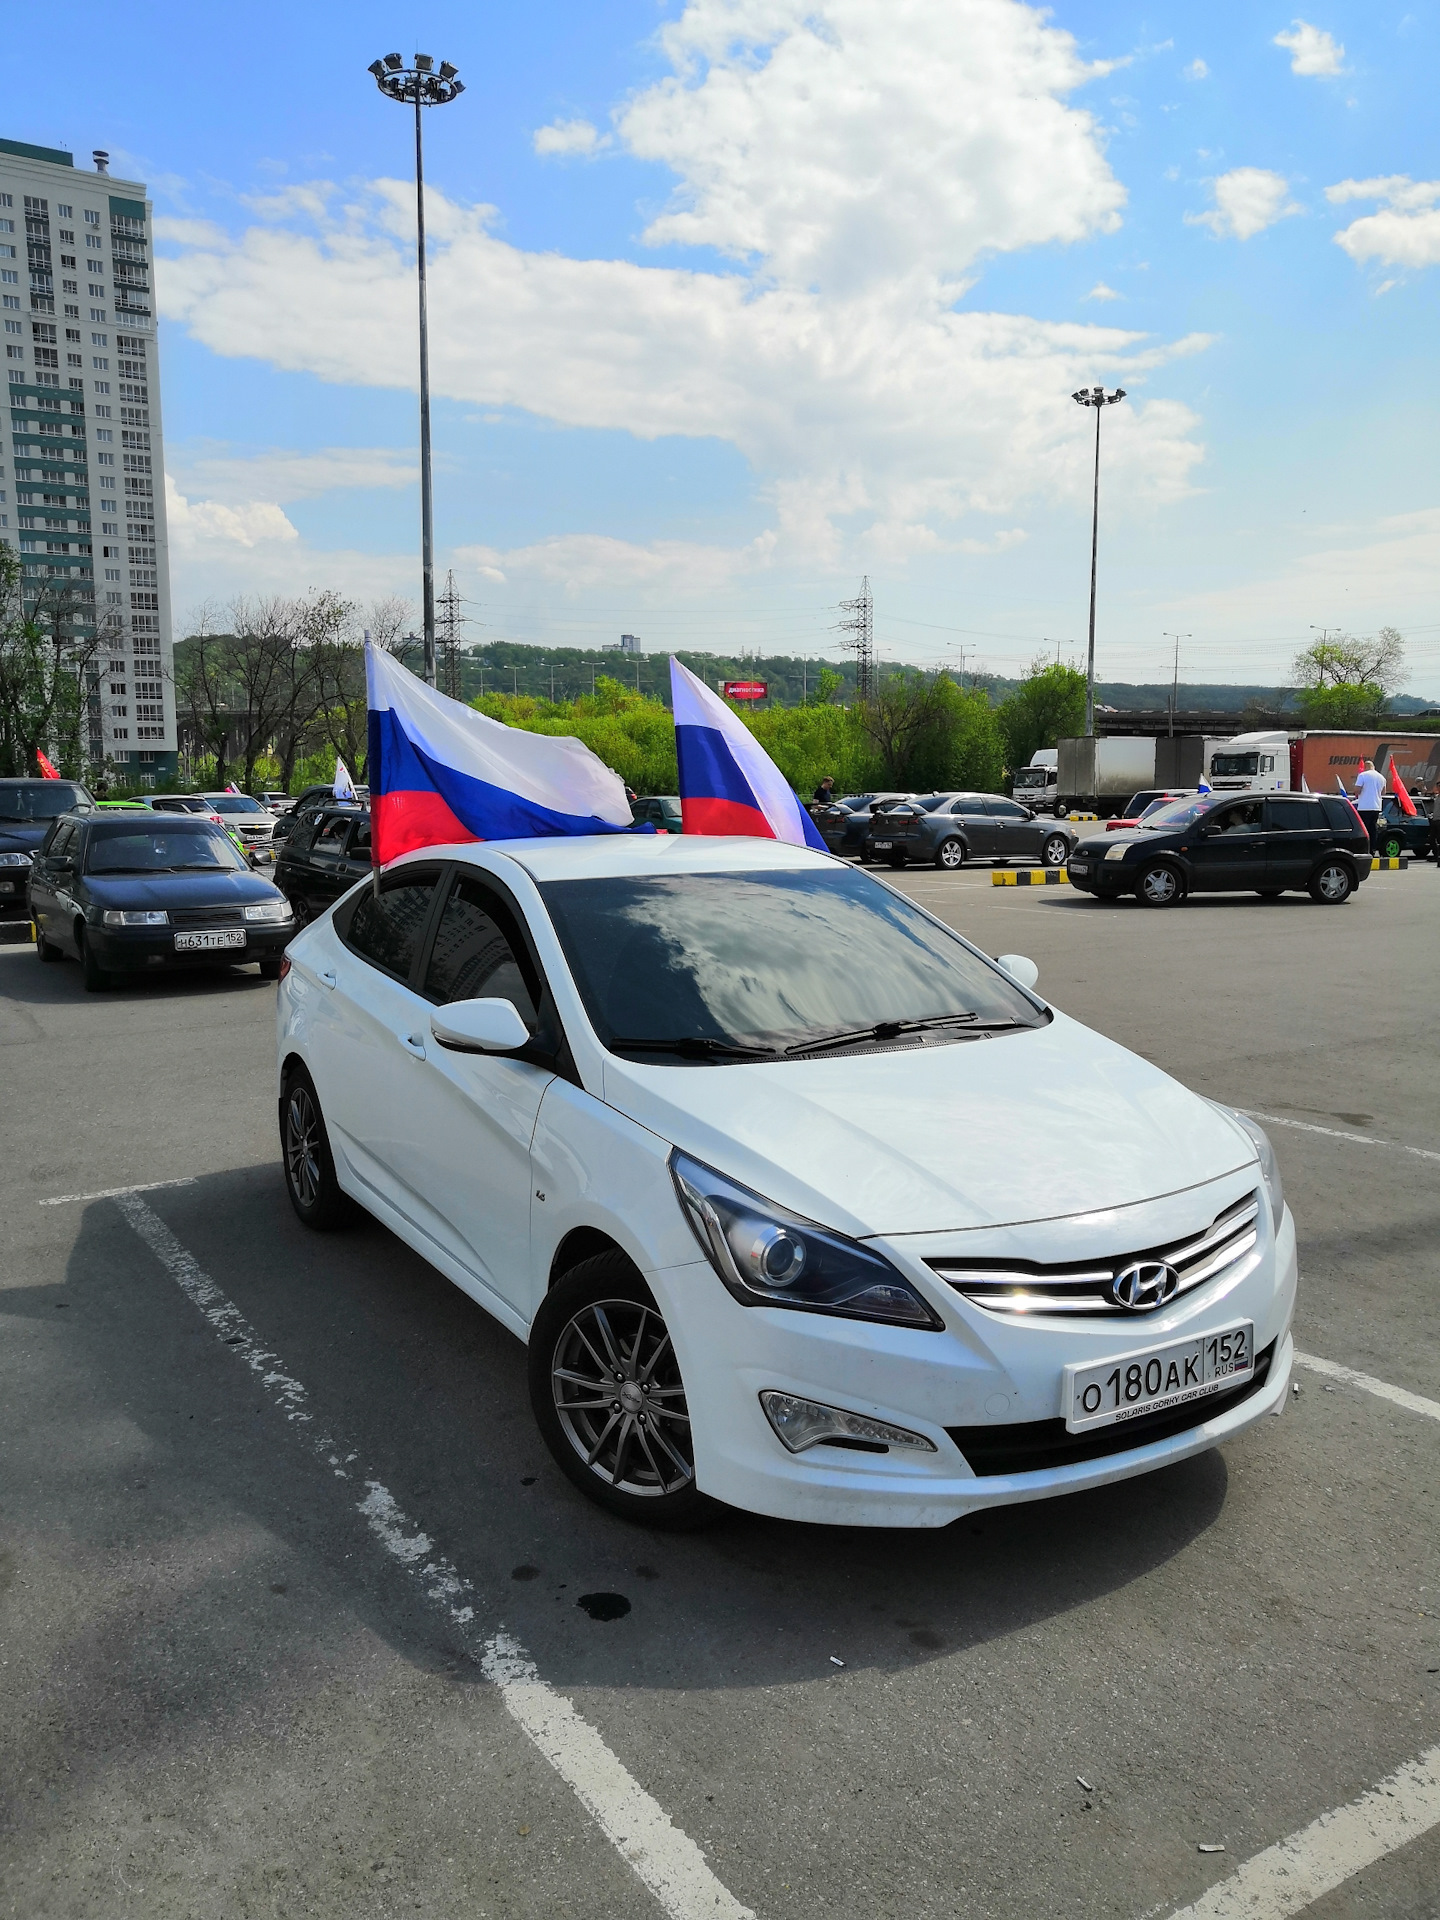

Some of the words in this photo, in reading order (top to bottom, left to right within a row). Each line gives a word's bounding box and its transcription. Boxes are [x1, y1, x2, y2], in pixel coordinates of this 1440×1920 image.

[225, 933, 242, 942] 152
[1207, 1330, 1246, 1366] 152
[1214, 1362, 1234, 1378] RUS
[1115, 1404, 1151, 1421] SOLARIS
[1152, 1395, 1180, 1410] GORKY
[1181, 1390, 1198, 1401] CAR
[1199, 1384, 1219, 1396] CLUB
